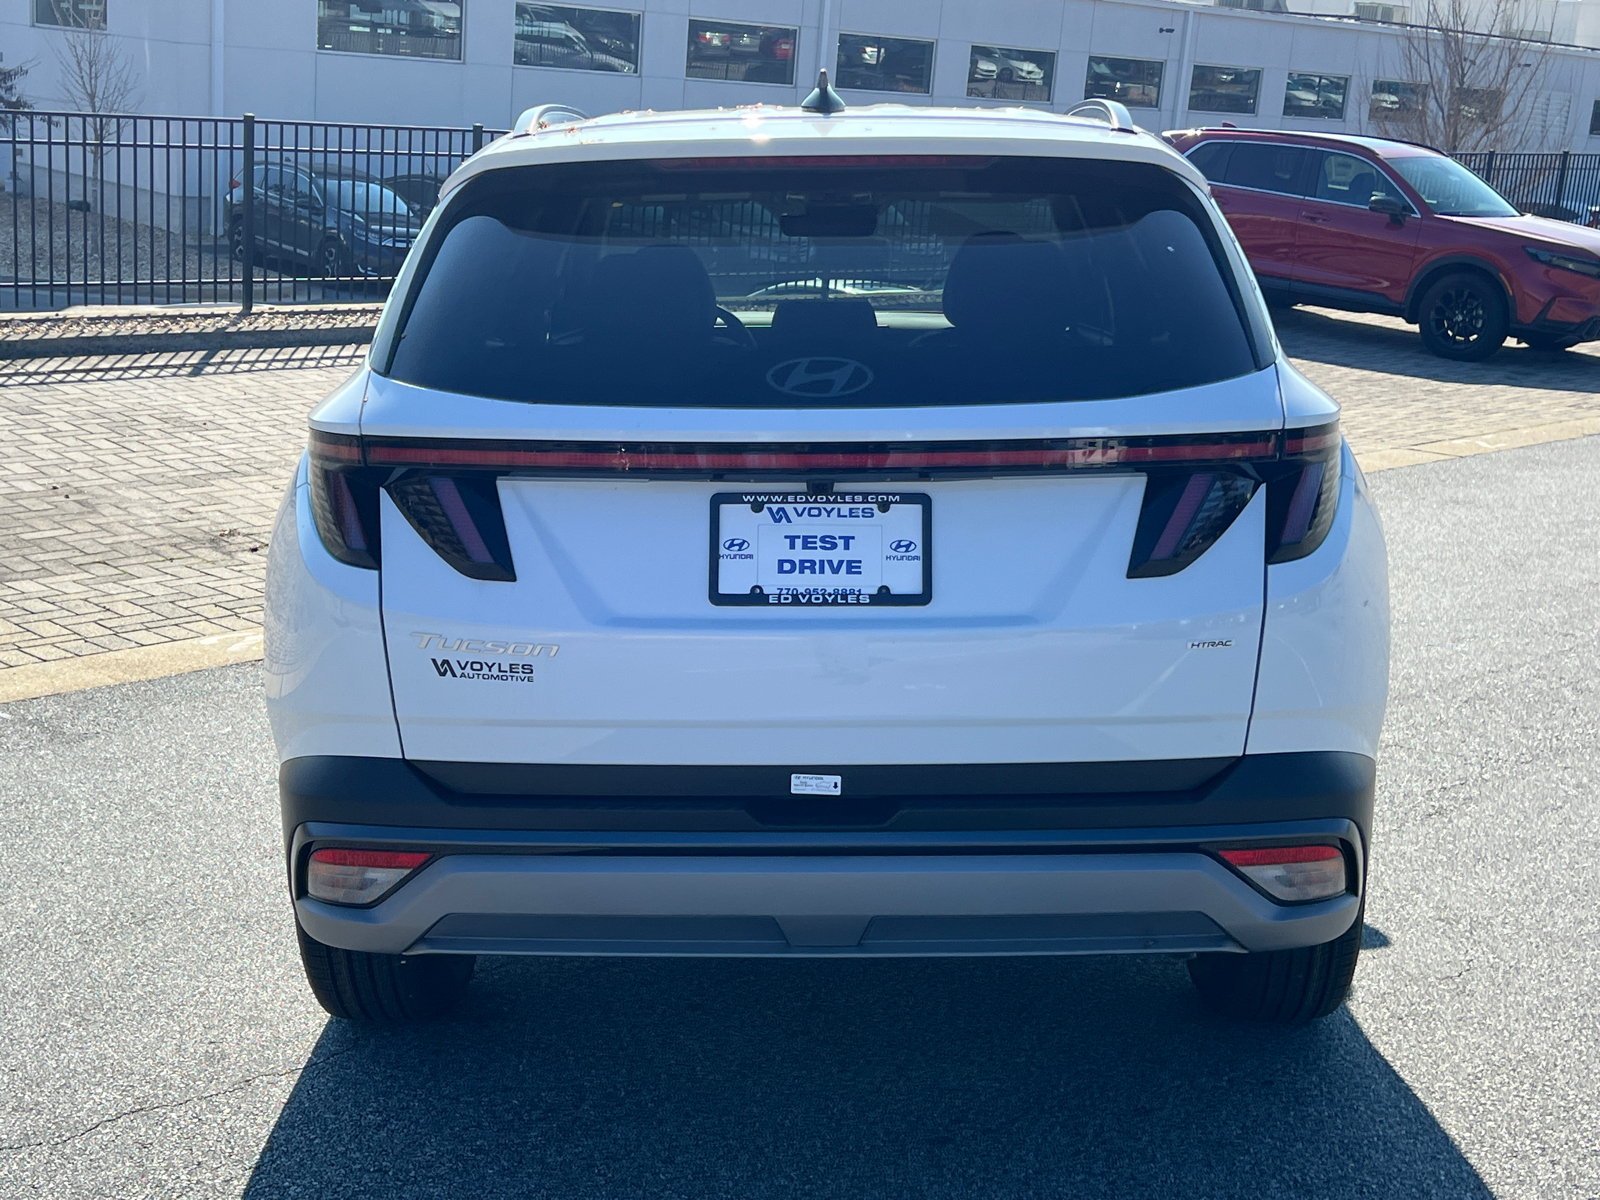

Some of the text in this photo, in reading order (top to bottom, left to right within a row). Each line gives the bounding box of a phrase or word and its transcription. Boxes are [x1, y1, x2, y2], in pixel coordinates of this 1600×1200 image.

[793, 507, 875, 518] VOYLES
[784, 535, 855, 550] TEST
[777, 559, 862, 575] DRIVE
[768, 594, 870, 603] ED VOYLES
[1190, 640, 1232, 649] HTRAC
[456, 660, 534, 674] VOYLES
[459, 672, 534, 683] AUTOMOTIVE
